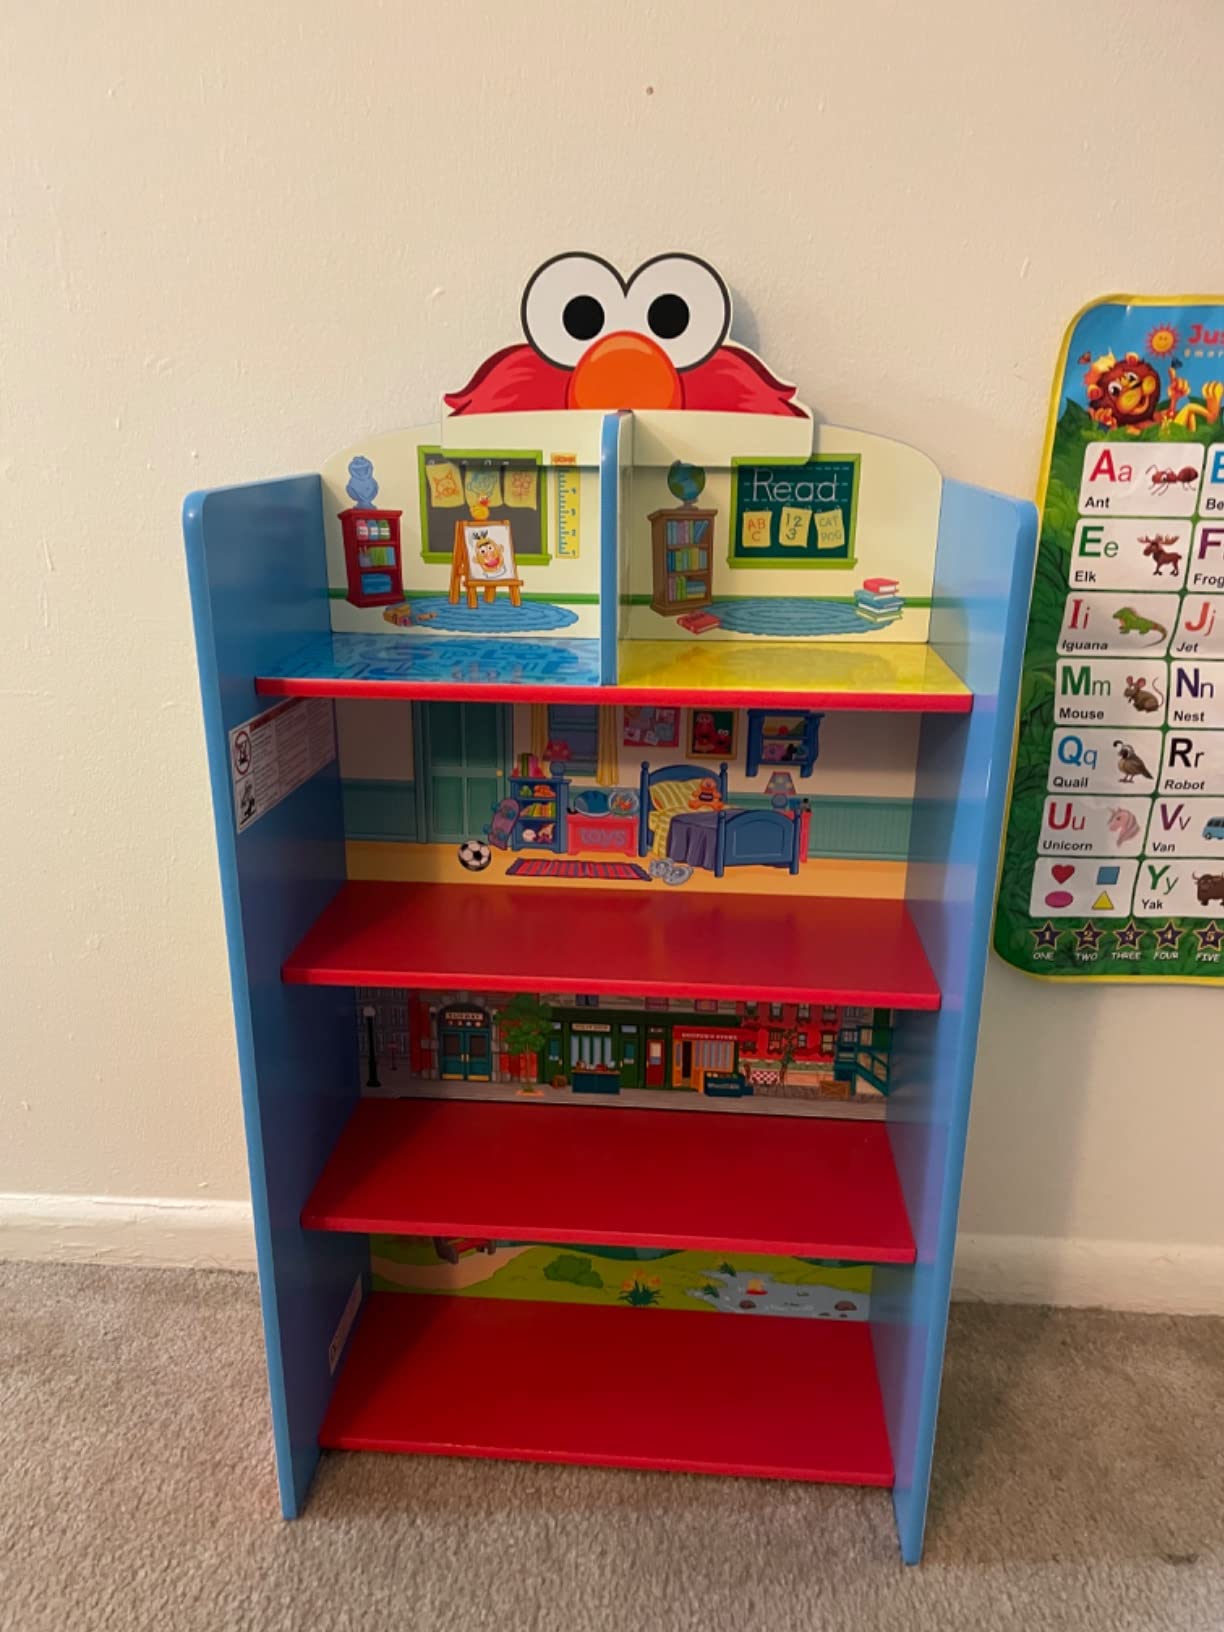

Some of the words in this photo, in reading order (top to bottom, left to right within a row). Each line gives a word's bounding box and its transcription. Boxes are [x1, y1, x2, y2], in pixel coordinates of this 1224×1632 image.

[1188, 323, 1224, 345] Ju
[1089, 449, 1133, 483] Aa
[752, 468, 838, 502] Read
[1085, 497, 1110, 509] Ant
[1078, 526, 1119, 558] Ee
[1198, 528, 1224, 560] F
[1074, 570, 1096, 583] Elk
[1193, 573, 1224, 588] Frog
[1184, 602, 1216, 637] Jj
[1062, 640, 1108, 651] Iguana
[1176, 642, 1198, 653] Jet
[1060, 665, 1111, 696] Mm
[1176, 667, 1214, 698] Nn
[1059, 708, 1104, 720] Mouse
[1173, 710, 1205, 722] Nest
[1057, 735, 1098, 769] Qq
[1168, 738, 1205, 768] Rr
[1052, 776, 1088, 789] Quail
[1164, 779, 1205, 791] Robot
[1048, 802, 1086, 831] Uu
[1160, 803, 1191, 831] Vv
[1042, 840, 1093, 852] Unicorn
[1152, 842, 1176, 853] Van
[1147, 864, 1179, 895] Yy
[1141, 899, 1163, 910] Yak
[1043, 931, 1051, 941] 1
[1083, 930, 1093, 941] 2
[1125, 931, 1134, 941] 3
[1163, 929, 1173, 940] 4
[1206, 931, 1215, 942] 5
[1033, 952, 1055, 961] ONE
[1075, 952, 1098, 961] TWO
[1111, 952, 1141, 961] THREE
[1153, 952, 1179, 961] FOUR
[1195, 952, 1221, 963] FIVE
